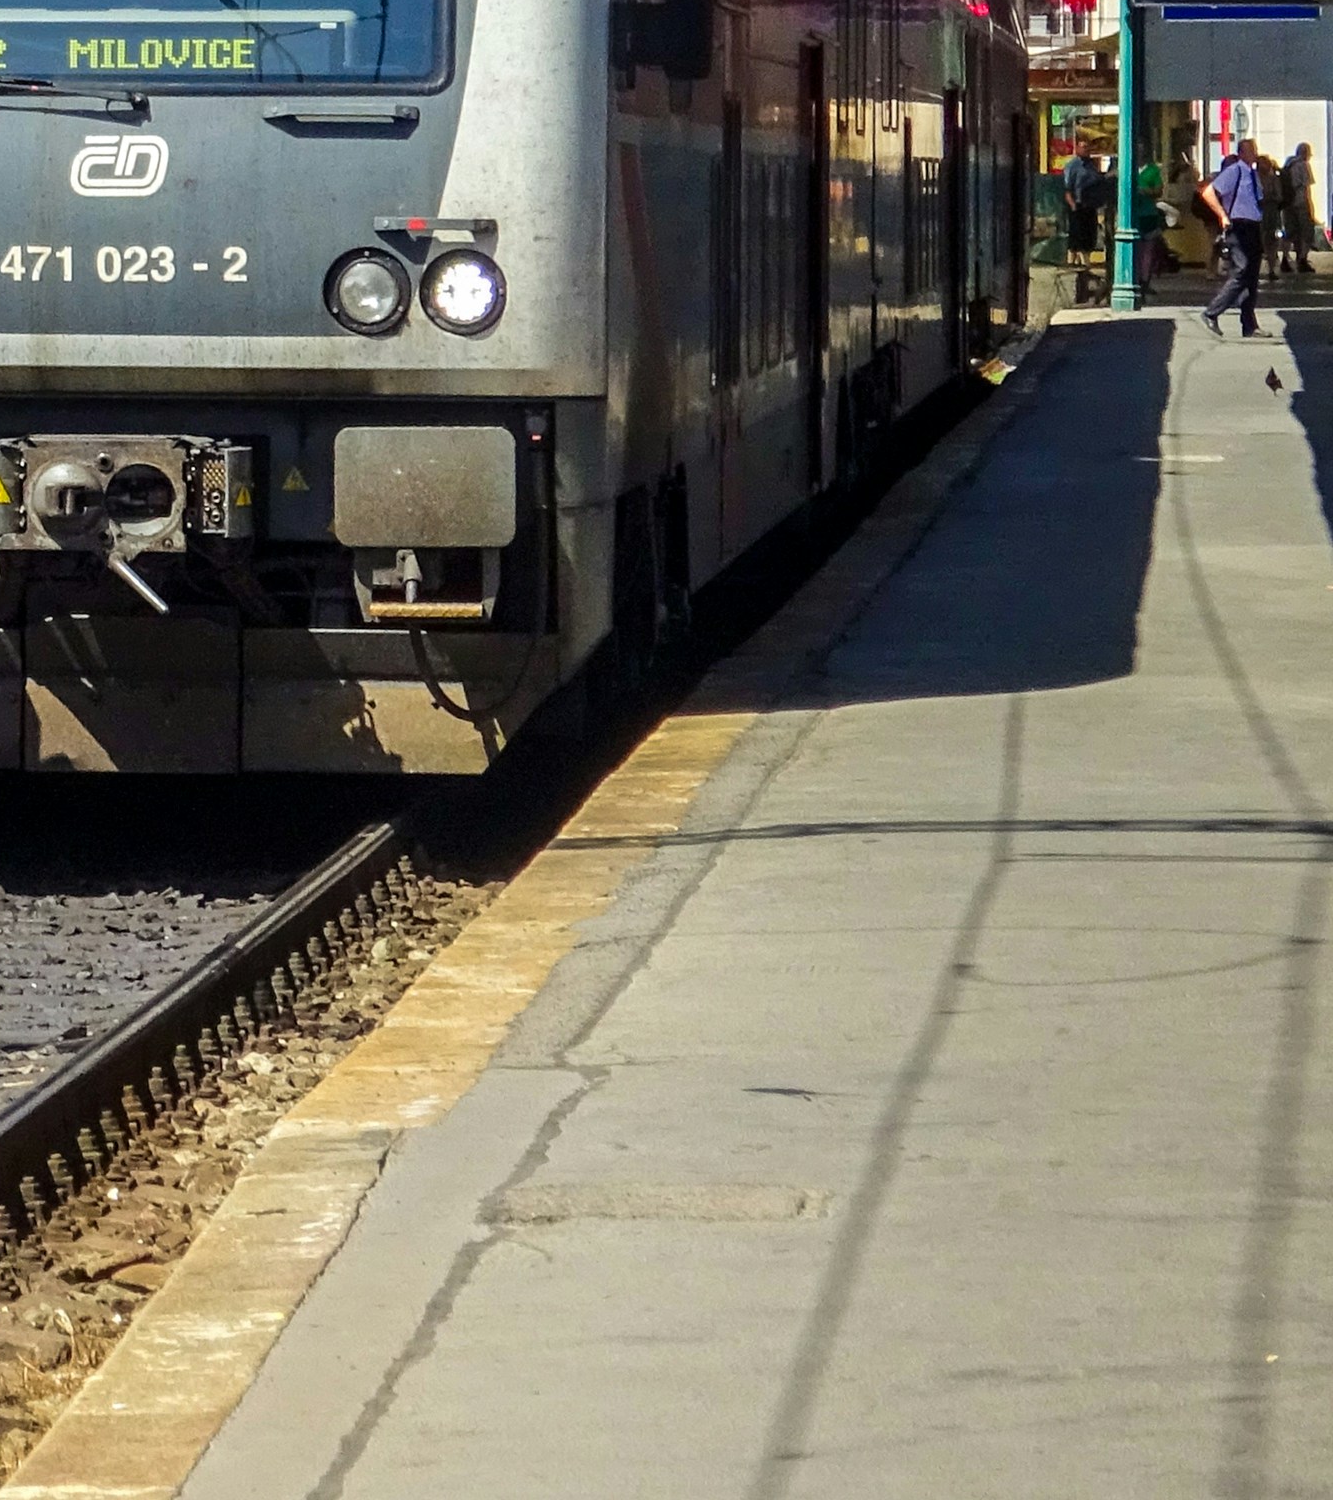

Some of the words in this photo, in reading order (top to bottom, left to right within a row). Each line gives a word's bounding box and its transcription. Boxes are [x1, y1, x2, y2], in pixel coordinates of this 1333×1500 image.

[69, 38, 255, 69] MILOVICE
[0, 245, 73, 283] 471
[96, 245, 176, 283] 023
